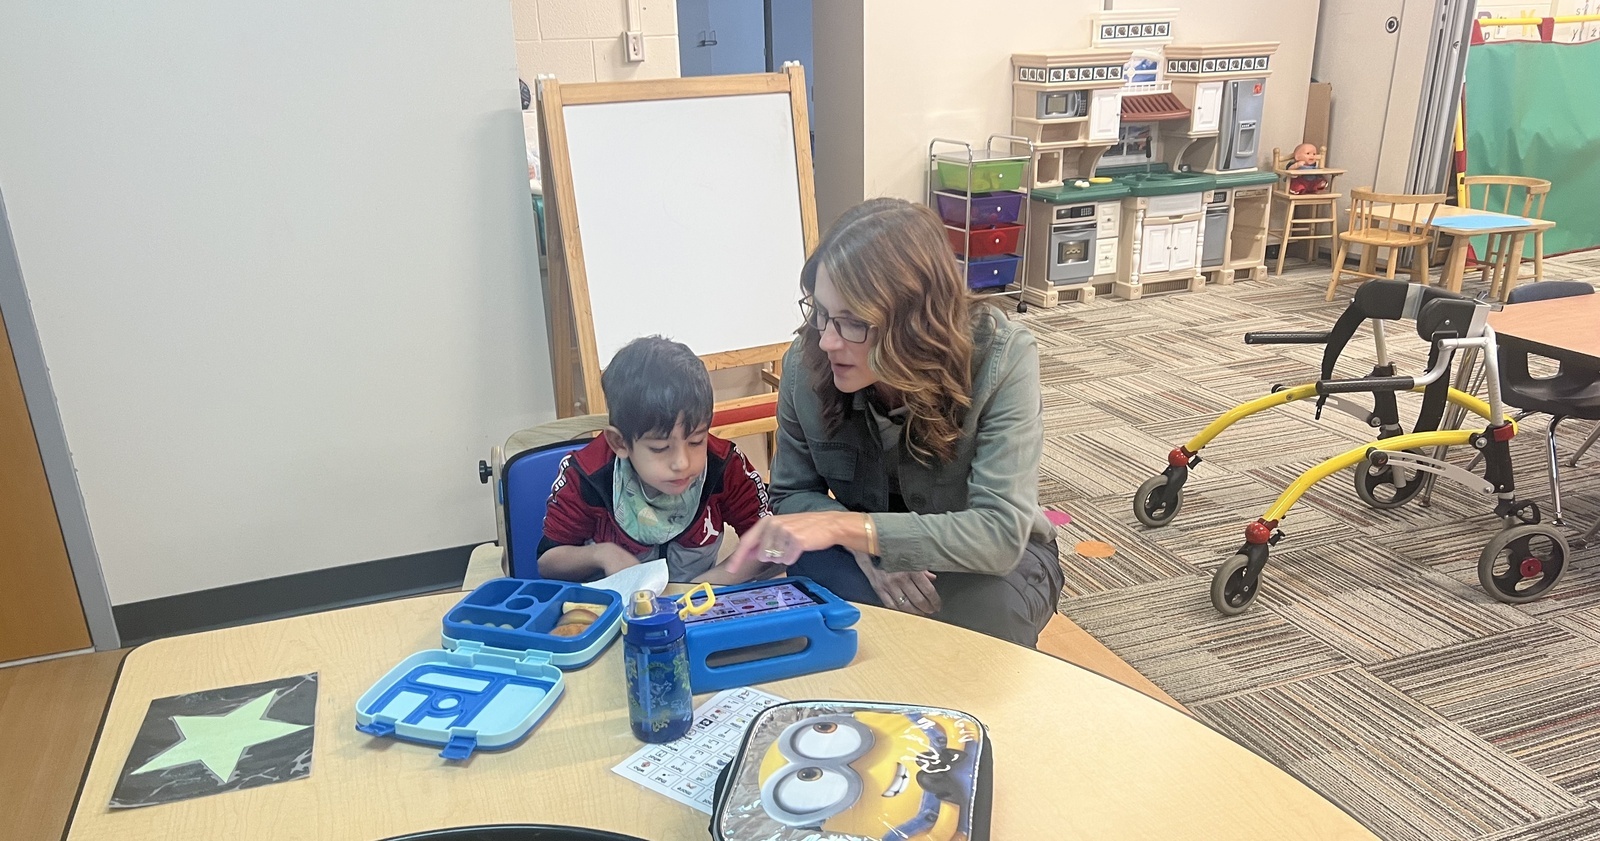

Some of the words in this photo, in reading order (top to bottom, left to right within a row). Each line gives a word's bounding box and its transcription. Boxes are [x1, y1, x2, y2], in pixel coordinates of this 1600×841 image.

[647, 754, 662, 763] what
[633, 765, 645, 773] who
[670, 765, 684, 773] here
[654, 776, 668, 784] that
[676, 786, 693, 796] more
